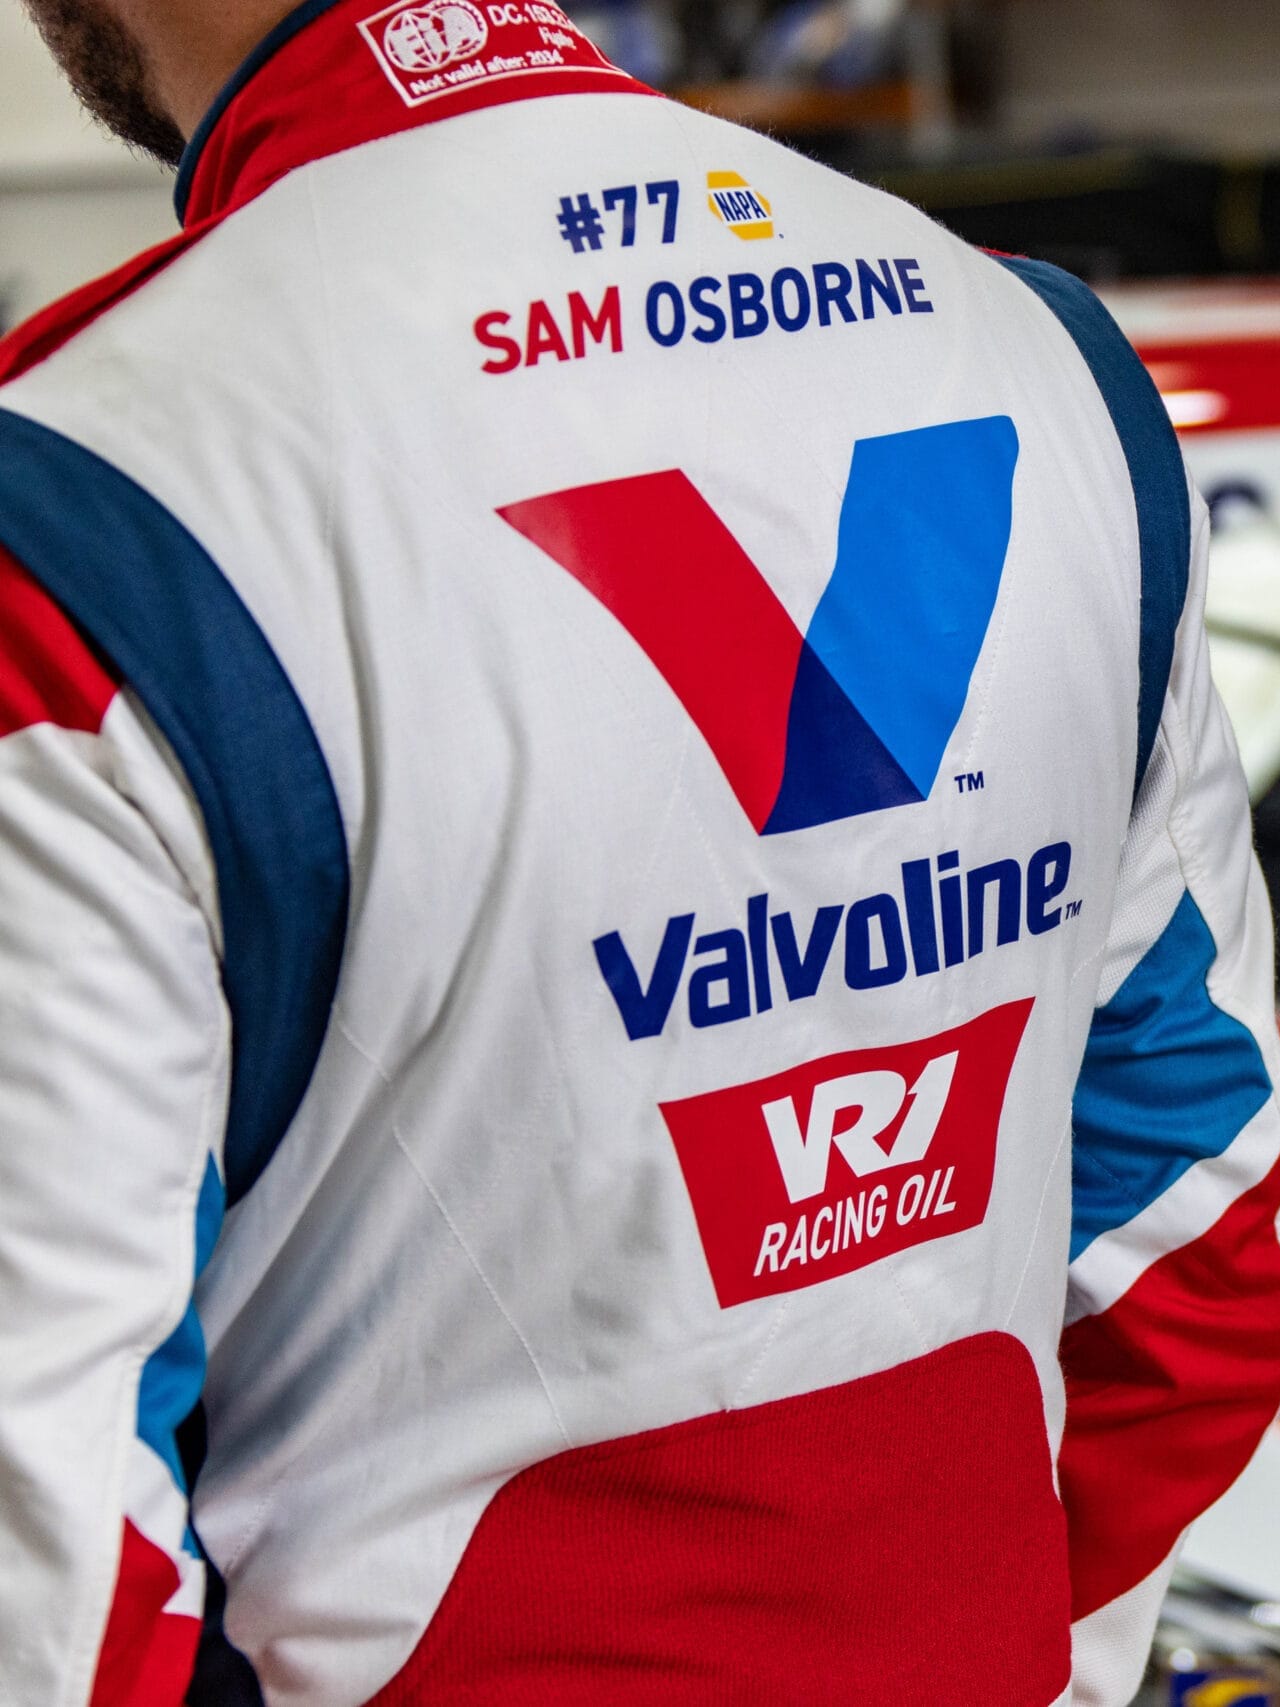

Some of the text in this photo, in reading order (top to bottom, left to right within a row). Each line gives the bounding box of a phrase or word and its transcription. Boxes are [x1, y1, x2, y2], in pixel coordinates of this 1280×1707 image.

[409, 74, 446, 95] Not
[443, 59, 487, 84] valid
[556, 179, 679, 254] #77
[713, 190, 767, 221] NAPA
[473, 258, 934, 374] SAM OSBORNE
[592, 841, 1072, 1041] Valvoline
[761, 1049, 960, 1204] VR1
[753, 1166, 957, 1277] RACING OIL
